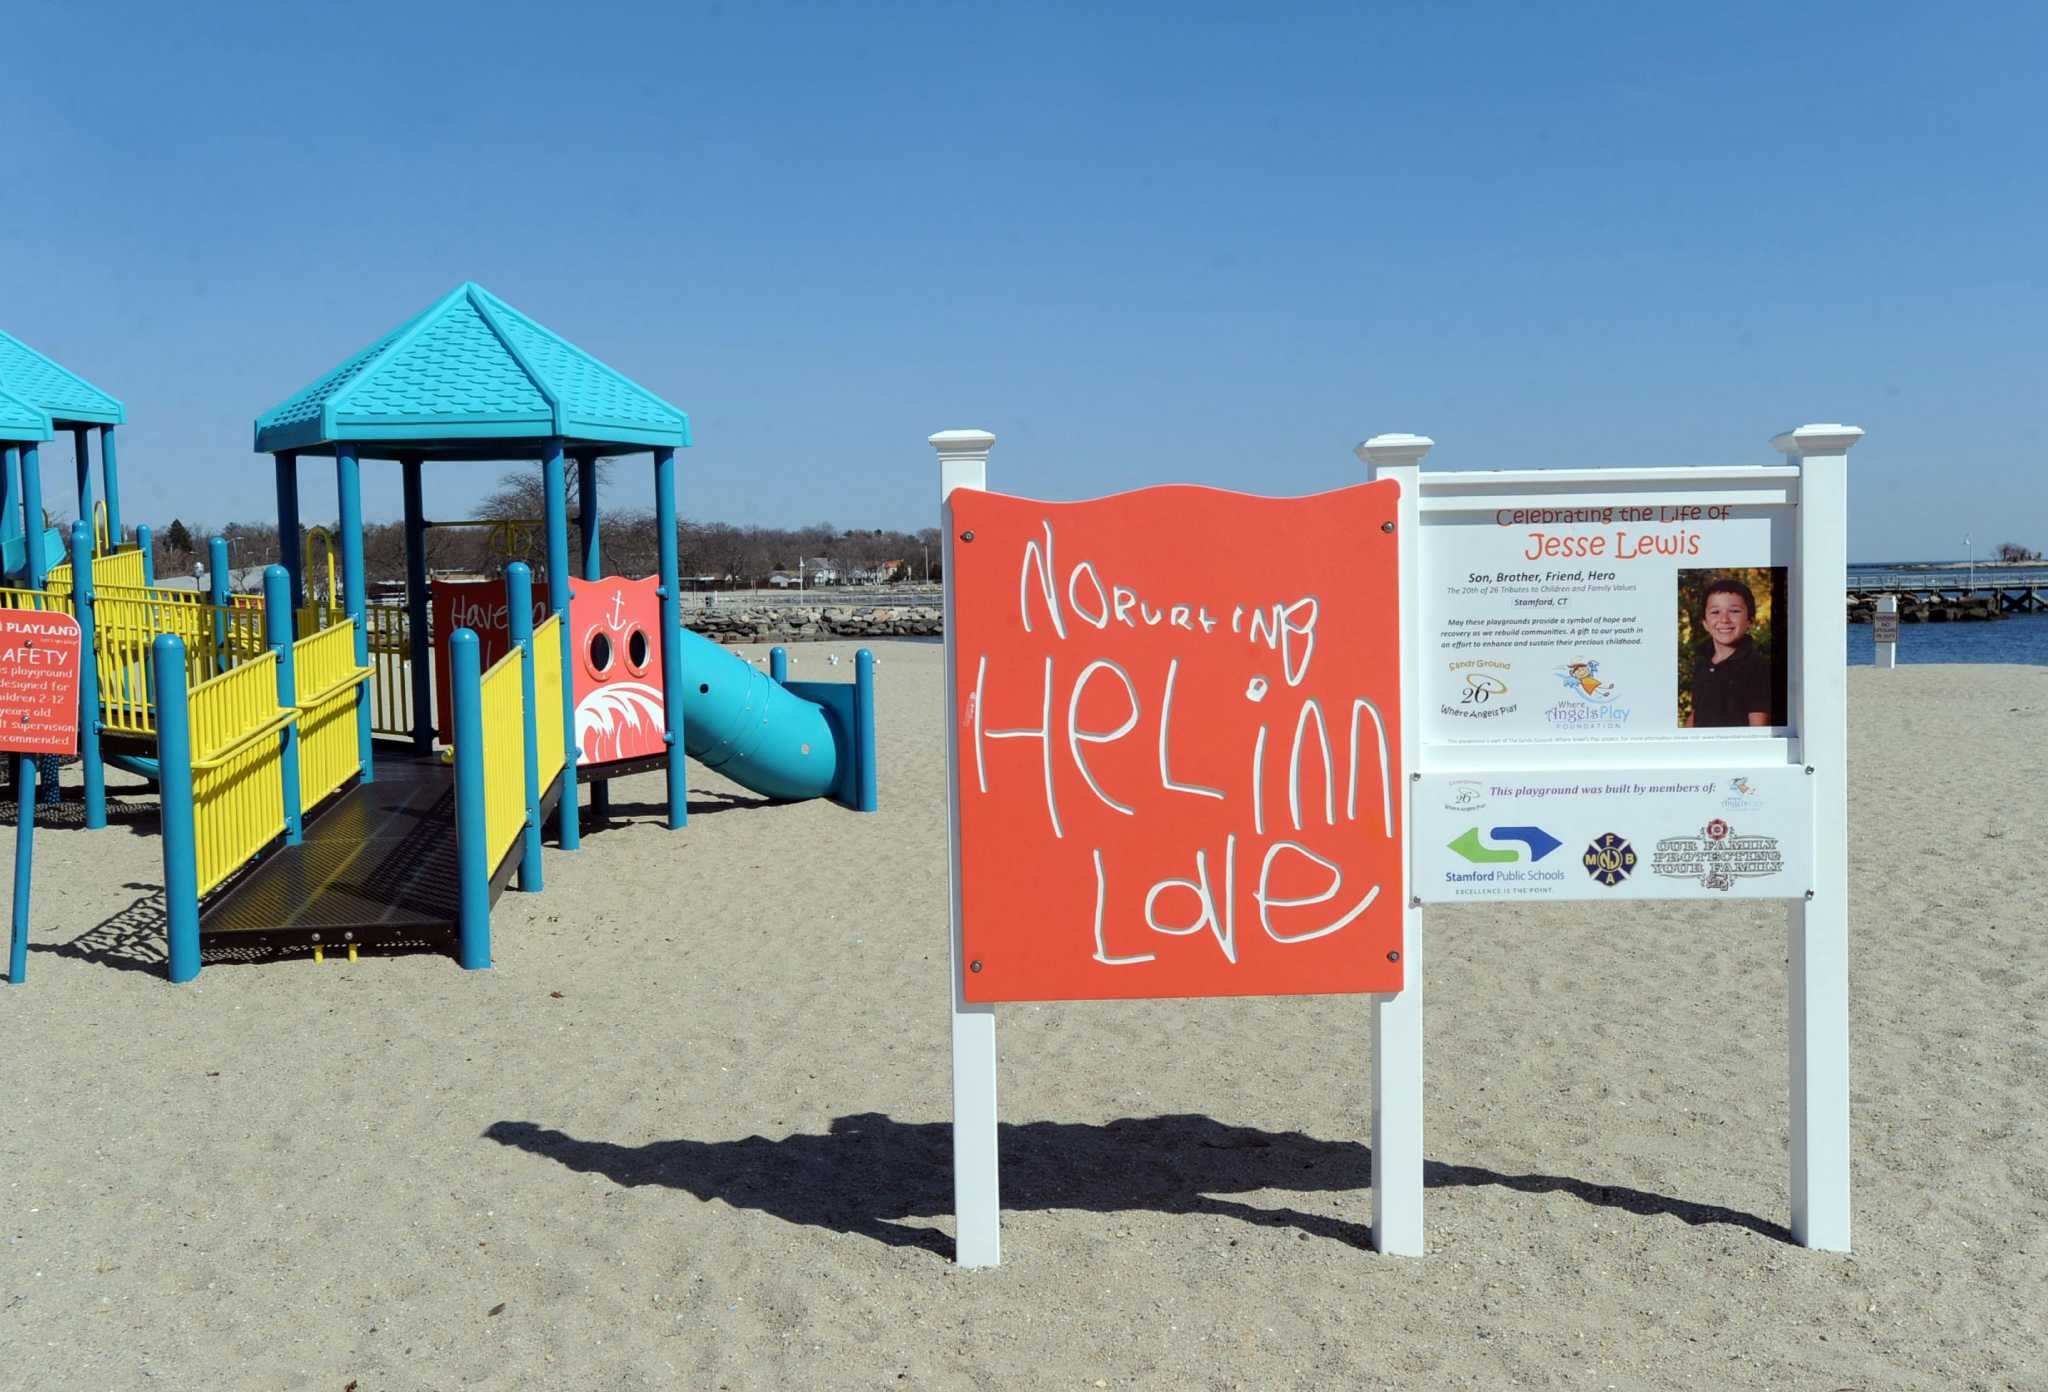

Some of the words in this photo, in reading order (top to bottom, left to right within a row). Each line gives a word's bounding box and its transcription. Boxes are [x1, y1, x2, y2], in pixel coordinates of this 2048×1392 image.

[1496, 507, 1613, 526] Celebrating
[1619, 506, 1653, 522] the
[1525, 533, 1606, 560] Jesse
[1615, 530, 1701, 559] Lewis
[1468, 573, 1492, 584] Son,
[1496, 572, 1542, 583] Brother,
[1545, 571, 1584, 582] Friend,
[1588, 571, 1615, 580] Hero
[1480, 586, 1488, 595] of
[1489, 586, 1499, 594] 26
[1514, 598, 1554, 607] Stamford,
[1557, 598, 1568, 606] CT
[1486, 618, 1530, 626] playgrounds
[1593, 616, 1601, 624] of
[1602, 616, 1620, 624] hope
[6, 622, 78, 637] PLAYLAND
[1452, 641, 1472, 649] effort
[0, 647, 69, 665] AFETY
[1476, 659, 1511, 670] Ground
[11, 665, 73, 679] playground
[52, 680, 71, 691] for
[0, 692, 36, 703] ildren
[1460, 681, 1491, 704] 26
[1557, 700, 1585, 708] Where
[1440, 704, 1469, 718] Where
[1469, 709, 1499, 719] Angels
[11, 720, 75, 733] supervision
[0, 735, 69, 745] commended
[1489, 786, 1512, 796] This
[1514, 784, 1579, 798] playground
[1581, 786, 1602, 795] was
[1605, 784, 1630, 794] built
[1633, 783, 1646, 796] by
[1649, 783, 1699, 793] members
[1703, 783, 1717, 794] of:
[1606, 835, 1615, 847] F
[1656, 841, 1698, 851] OUR
[1703, 839, 1778, 851] FAMILY
[1585, 854, 1597, 865] M
[1625, 853, 1634, 865] B
[1653, 851, 1781, 863] PROTECTING
[1651, 863, 1704, 874] YOUR
[1709, 861, 1784, 873] FAMILY
[1446, 871, 1494, 882] Stamford
[1496, 871, 1526, 881] Public
[1527, 870, 1565, 880] Schools
[1606, 873, 1616, 884] A
